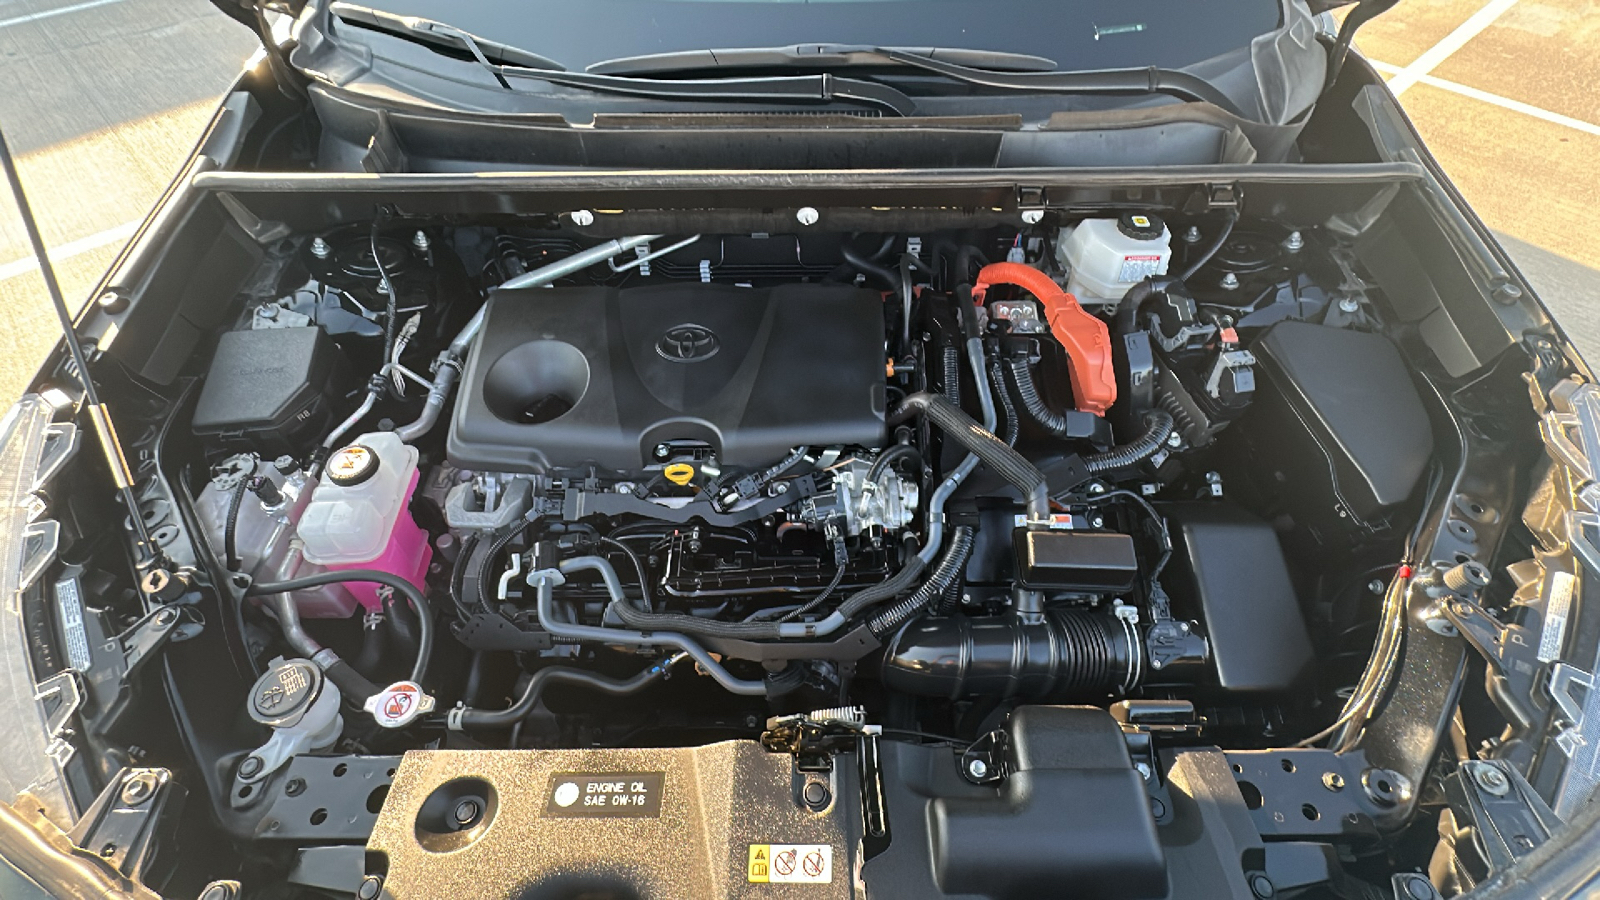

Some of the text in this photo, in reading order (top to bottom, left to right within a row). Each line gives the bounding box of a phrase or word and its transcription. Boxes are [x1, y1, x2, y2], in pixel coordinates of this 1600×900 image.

[586, 781, 648, 793] ENGINE OIL
[583, 795, 607, 806] SAE
